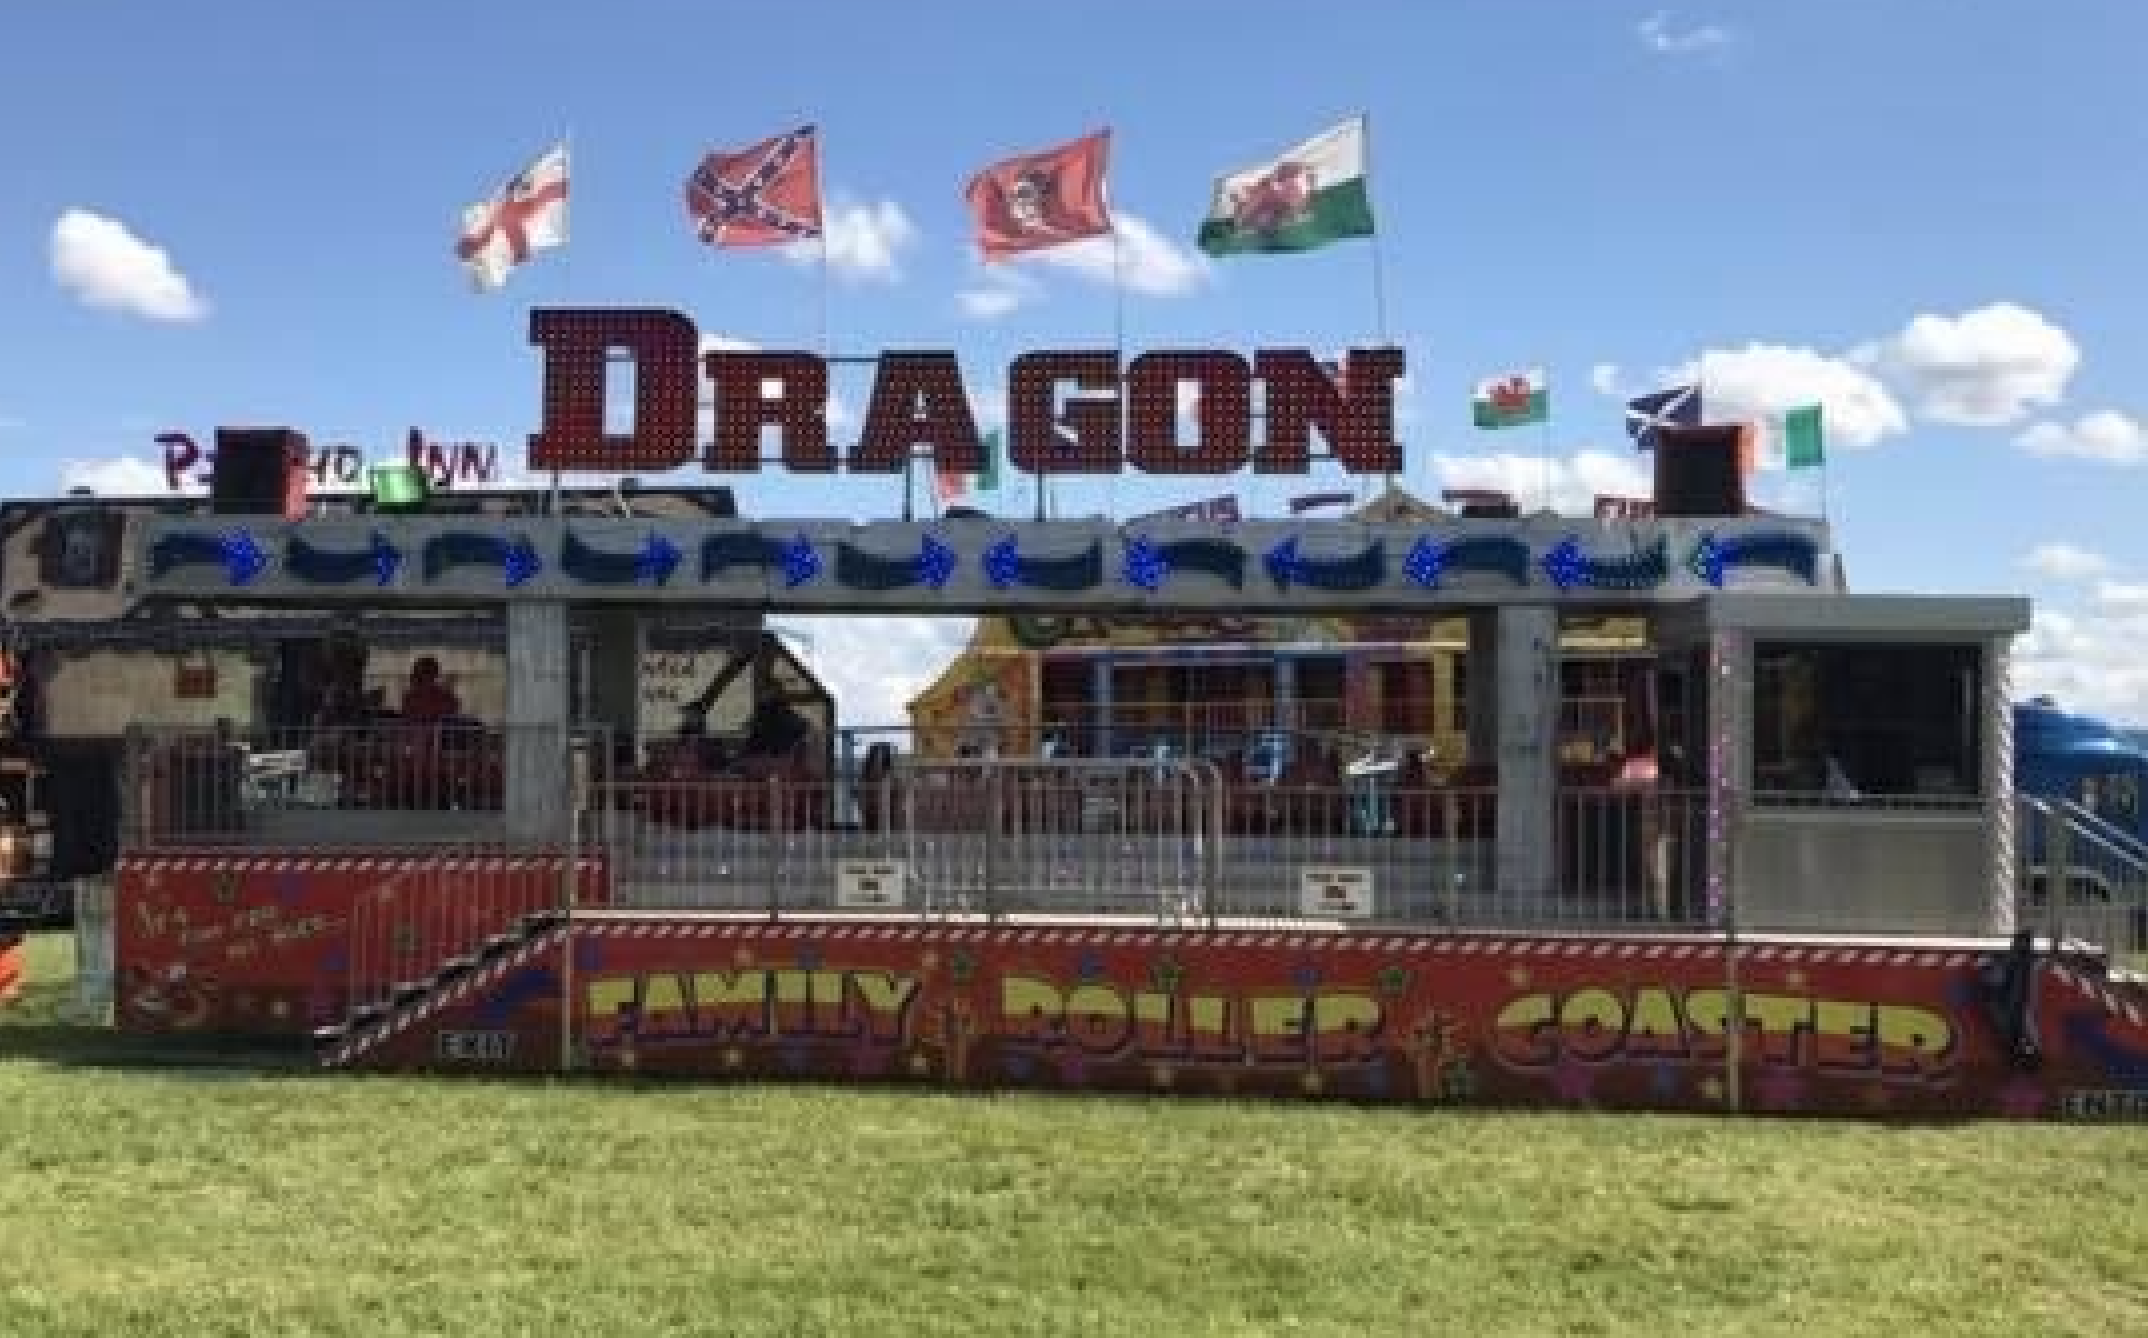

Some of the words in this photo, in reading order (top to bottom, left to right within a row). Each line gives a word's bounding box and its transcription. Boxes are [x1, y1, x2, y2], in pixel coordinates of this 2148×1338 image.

[529, 307, 1404, 475] DRAGON
[582, 968, 920, 1042] FAMILY
[998, 975, 1386, 1064] ROLLER
[1490, 986, 1955, 1086] COASTER
